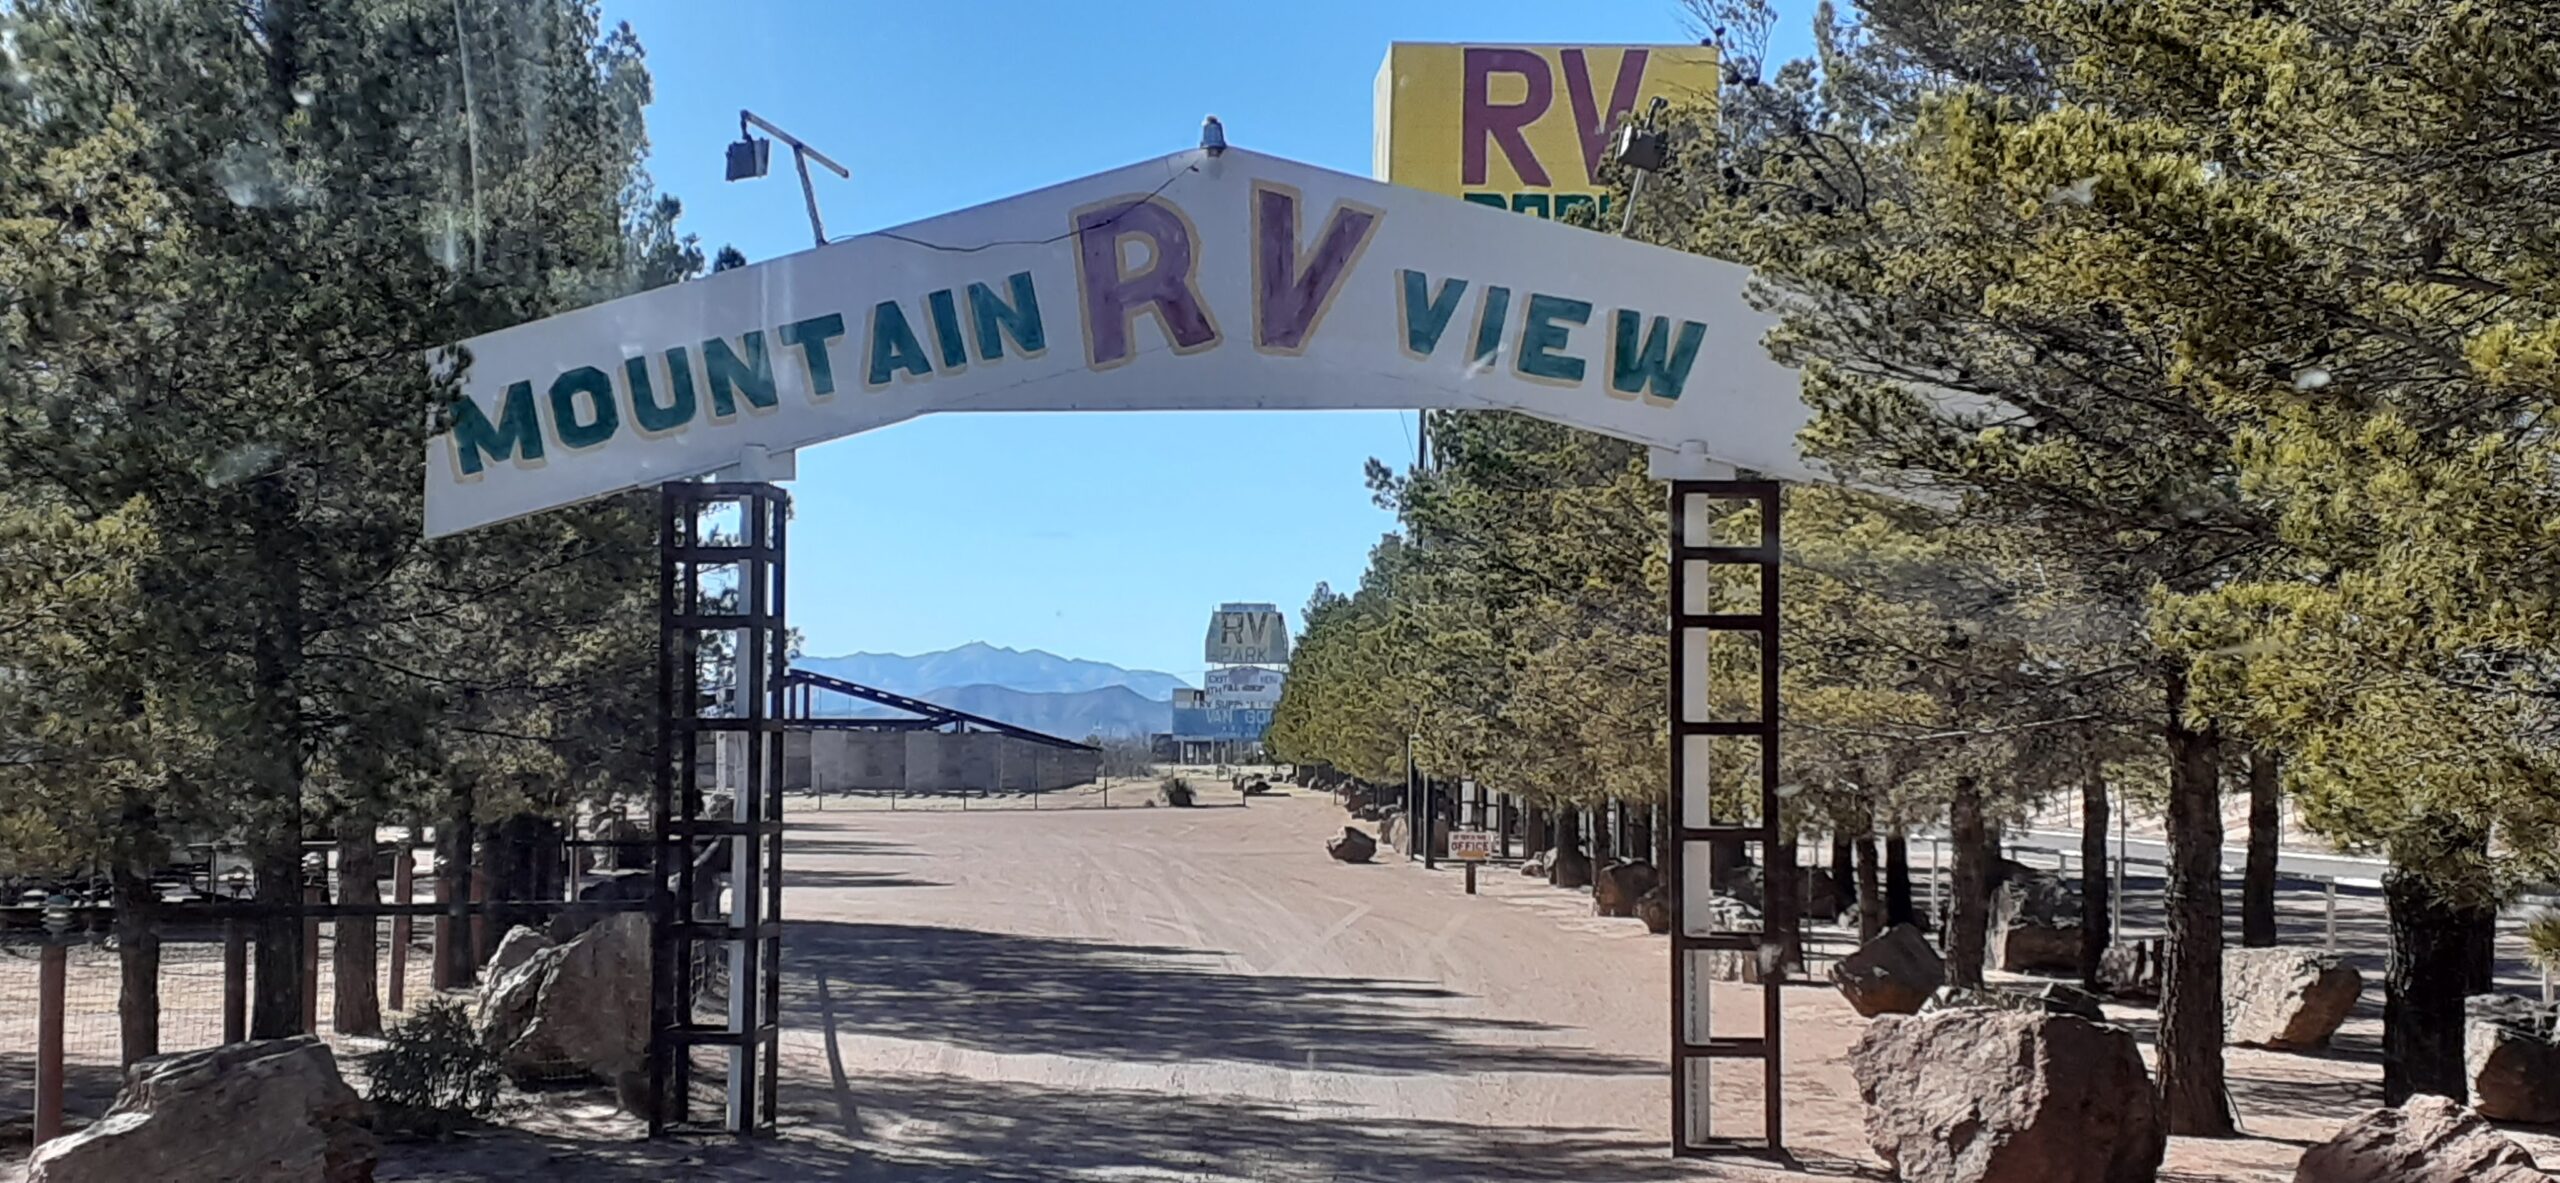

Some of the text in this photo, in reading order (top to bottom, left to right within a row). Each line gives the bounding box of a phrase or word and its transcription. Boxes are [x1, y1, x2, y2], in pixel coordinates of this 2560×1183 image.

[1462, 47, 1650, 187] RV
[450, 180, 1707, 479] MOUNTAIN RV VIEW
[1221, 611, 1268, 644] RV
[1221, 646, 1269, 662] PARK
[1450, 841, 1489, 852] OFFICE
